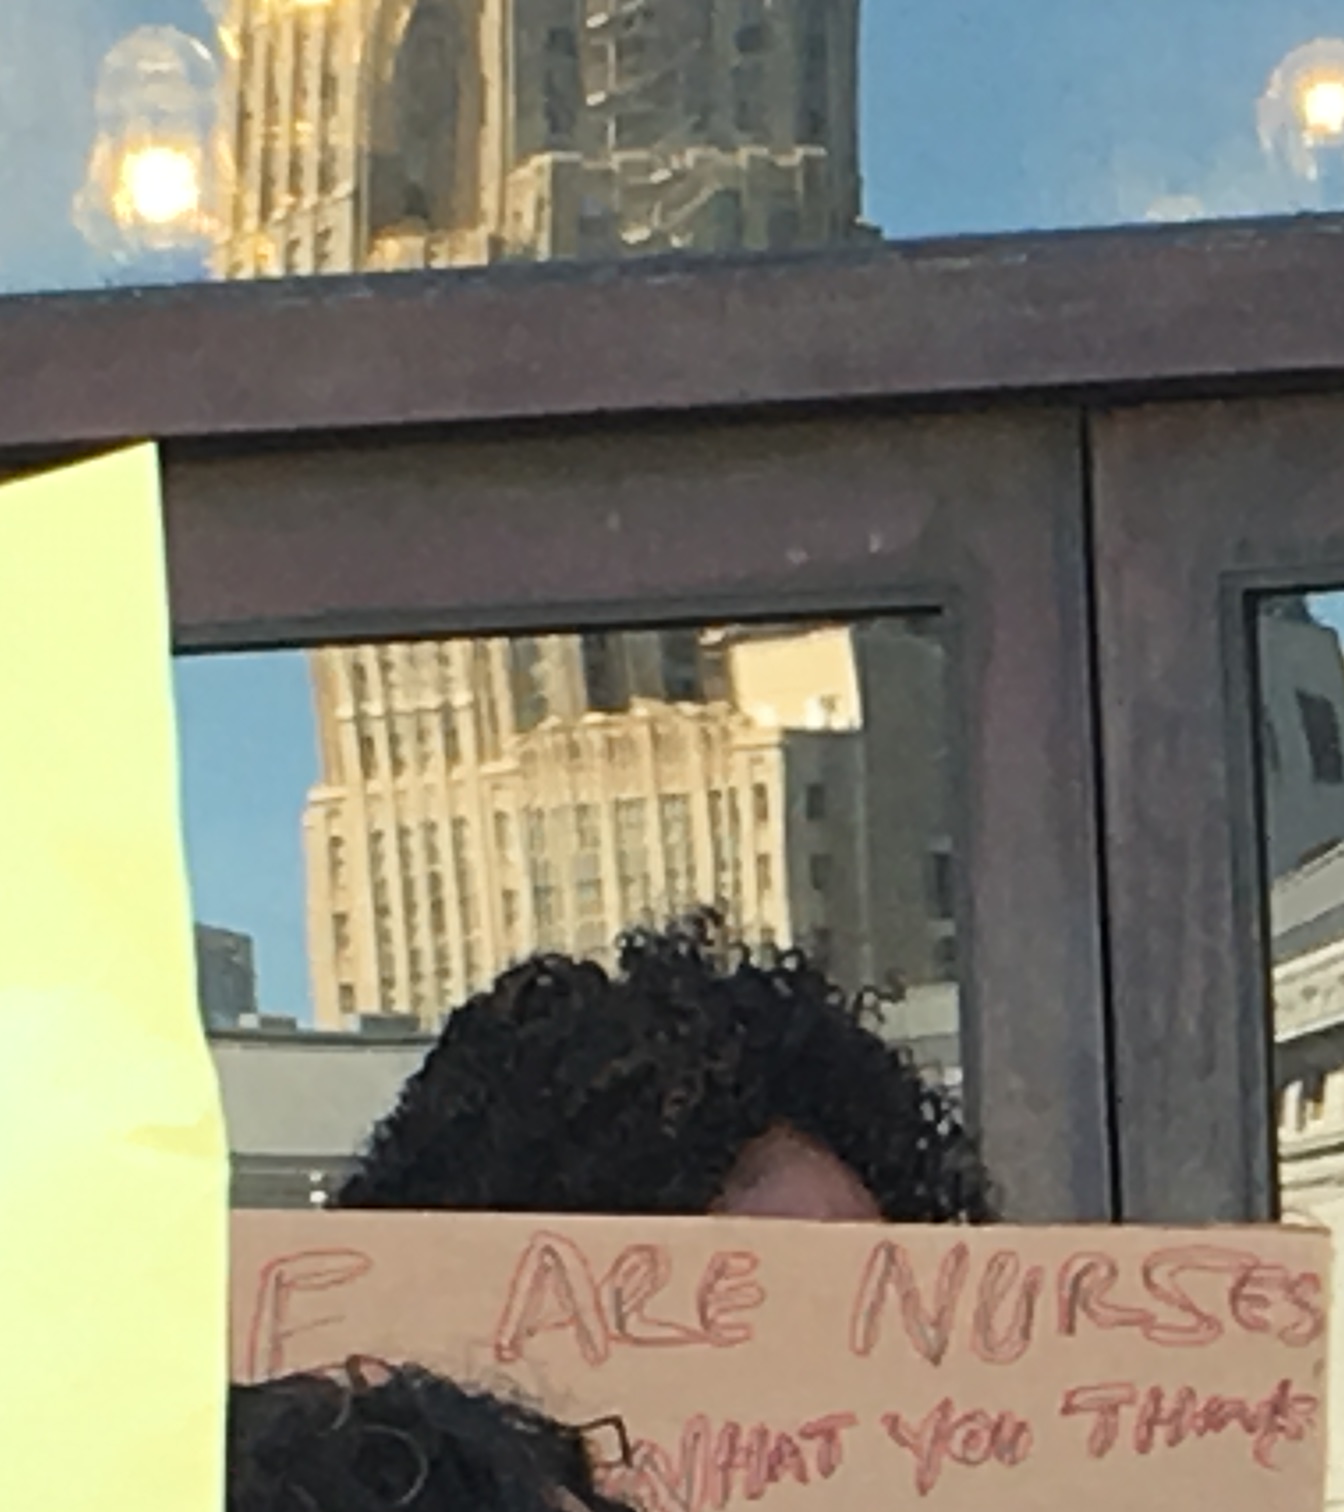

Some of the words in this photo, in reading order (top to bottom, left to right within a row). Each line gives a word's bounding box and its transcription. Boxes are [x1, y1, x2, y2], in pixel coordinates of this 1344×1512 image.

[494, 1229, 768, 1365] ARE
[849, 1239, 1326, 1367] NURSES
[881, 1396, 1034, 1498] YOU
